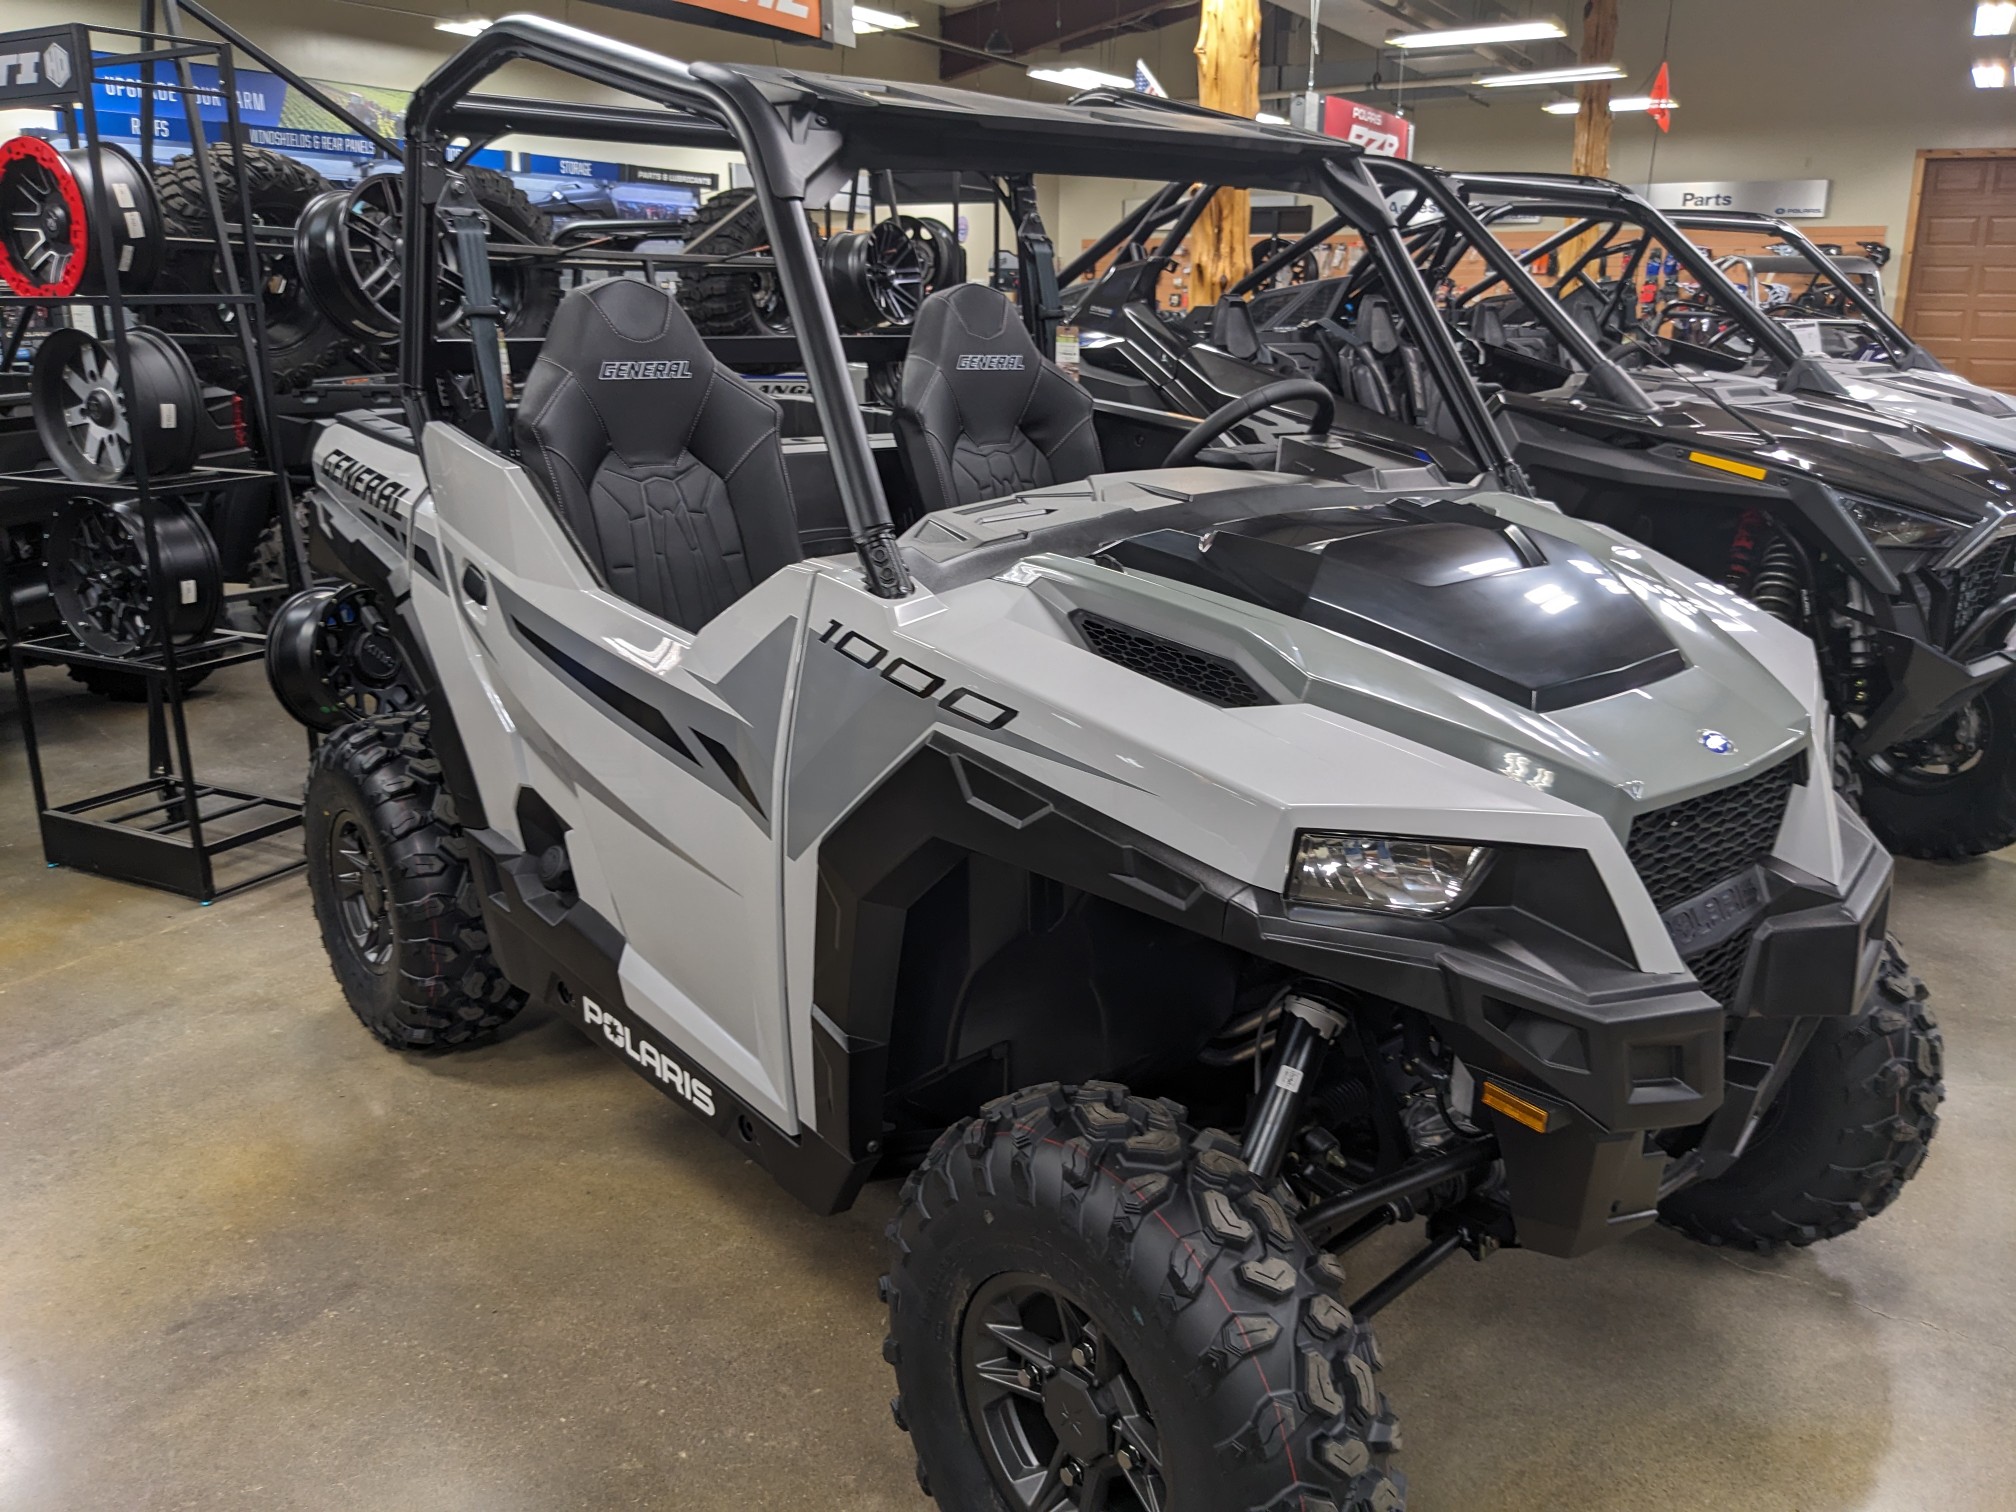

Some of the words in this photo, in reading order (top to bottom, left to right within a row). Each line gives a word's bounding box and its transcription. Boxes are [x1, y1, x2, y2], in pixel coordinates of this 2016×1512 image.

[104, 76, 177, 102] UPGADE
[235, 91, 266, 111] ARM
[131, 117, 170, 138] RFS
[249, 129, 312, 149] WINDSHIELDS
[321, 136, 345, 152] REAR
[345, 138, 376, 155] PANELS
[560, 160, 592, 176] STORAGE
[1682, 192, 1733, 207] Parts
[598, 360, 693, 381] GENERAL
[956, 354, 1026, 371] GENERAL
[759, 385, 813, 395] ANG
[321, 448, 411, 521] GENERAL
[818, 618, 1020, 731] 1000
[582, 995, 716, 1117] POLARIS
